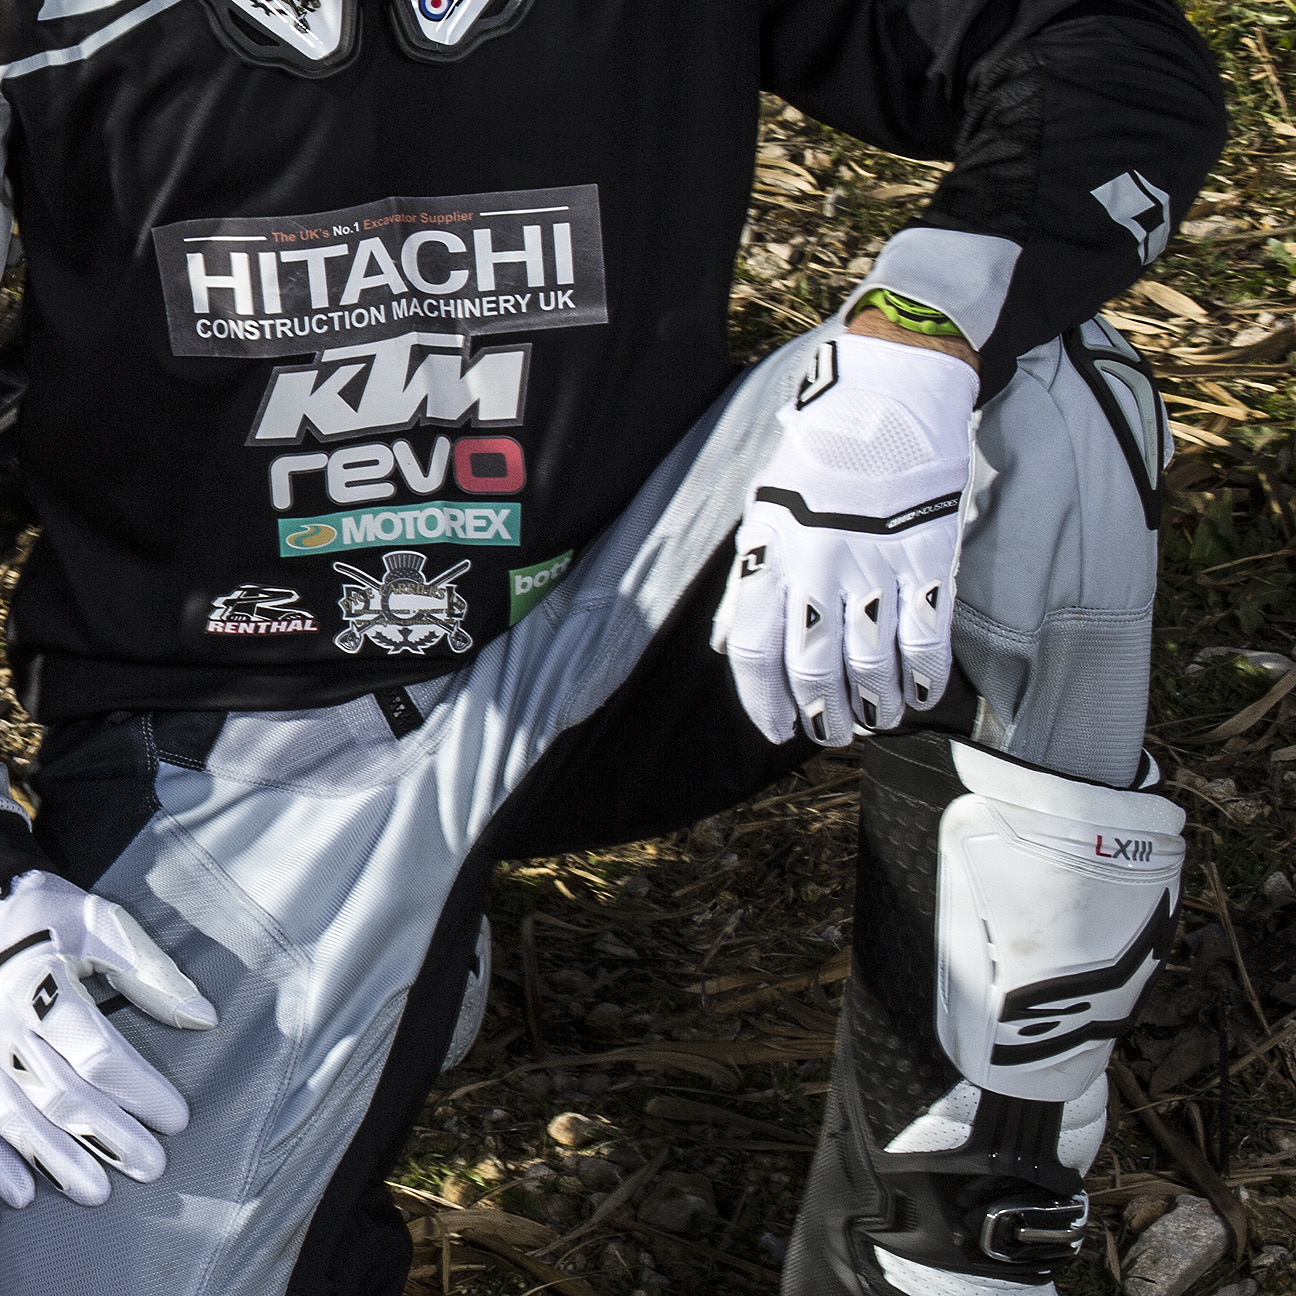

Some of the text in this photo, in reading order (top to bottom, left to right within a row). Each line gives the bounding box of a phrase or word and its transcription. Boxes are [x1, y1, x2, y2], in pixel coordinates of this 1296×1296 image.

[272, 210, 474, 244] The UK's No.1 Excavator Supplier
[185, 222, 576, 316] HITACHI
[195, 288, 576, 341] CONSTRUCTION MACHINERY UK
[254, 332, 525, 440] KTM
[269, 435, 526, 510] revo
[341, 508, 512, 546] MOTOREX
[378, 583, 447, 600] CARRIERS
[206, 619, 319, 634] RENTHAL
[1095, 834, 1154, 863] LXIII
